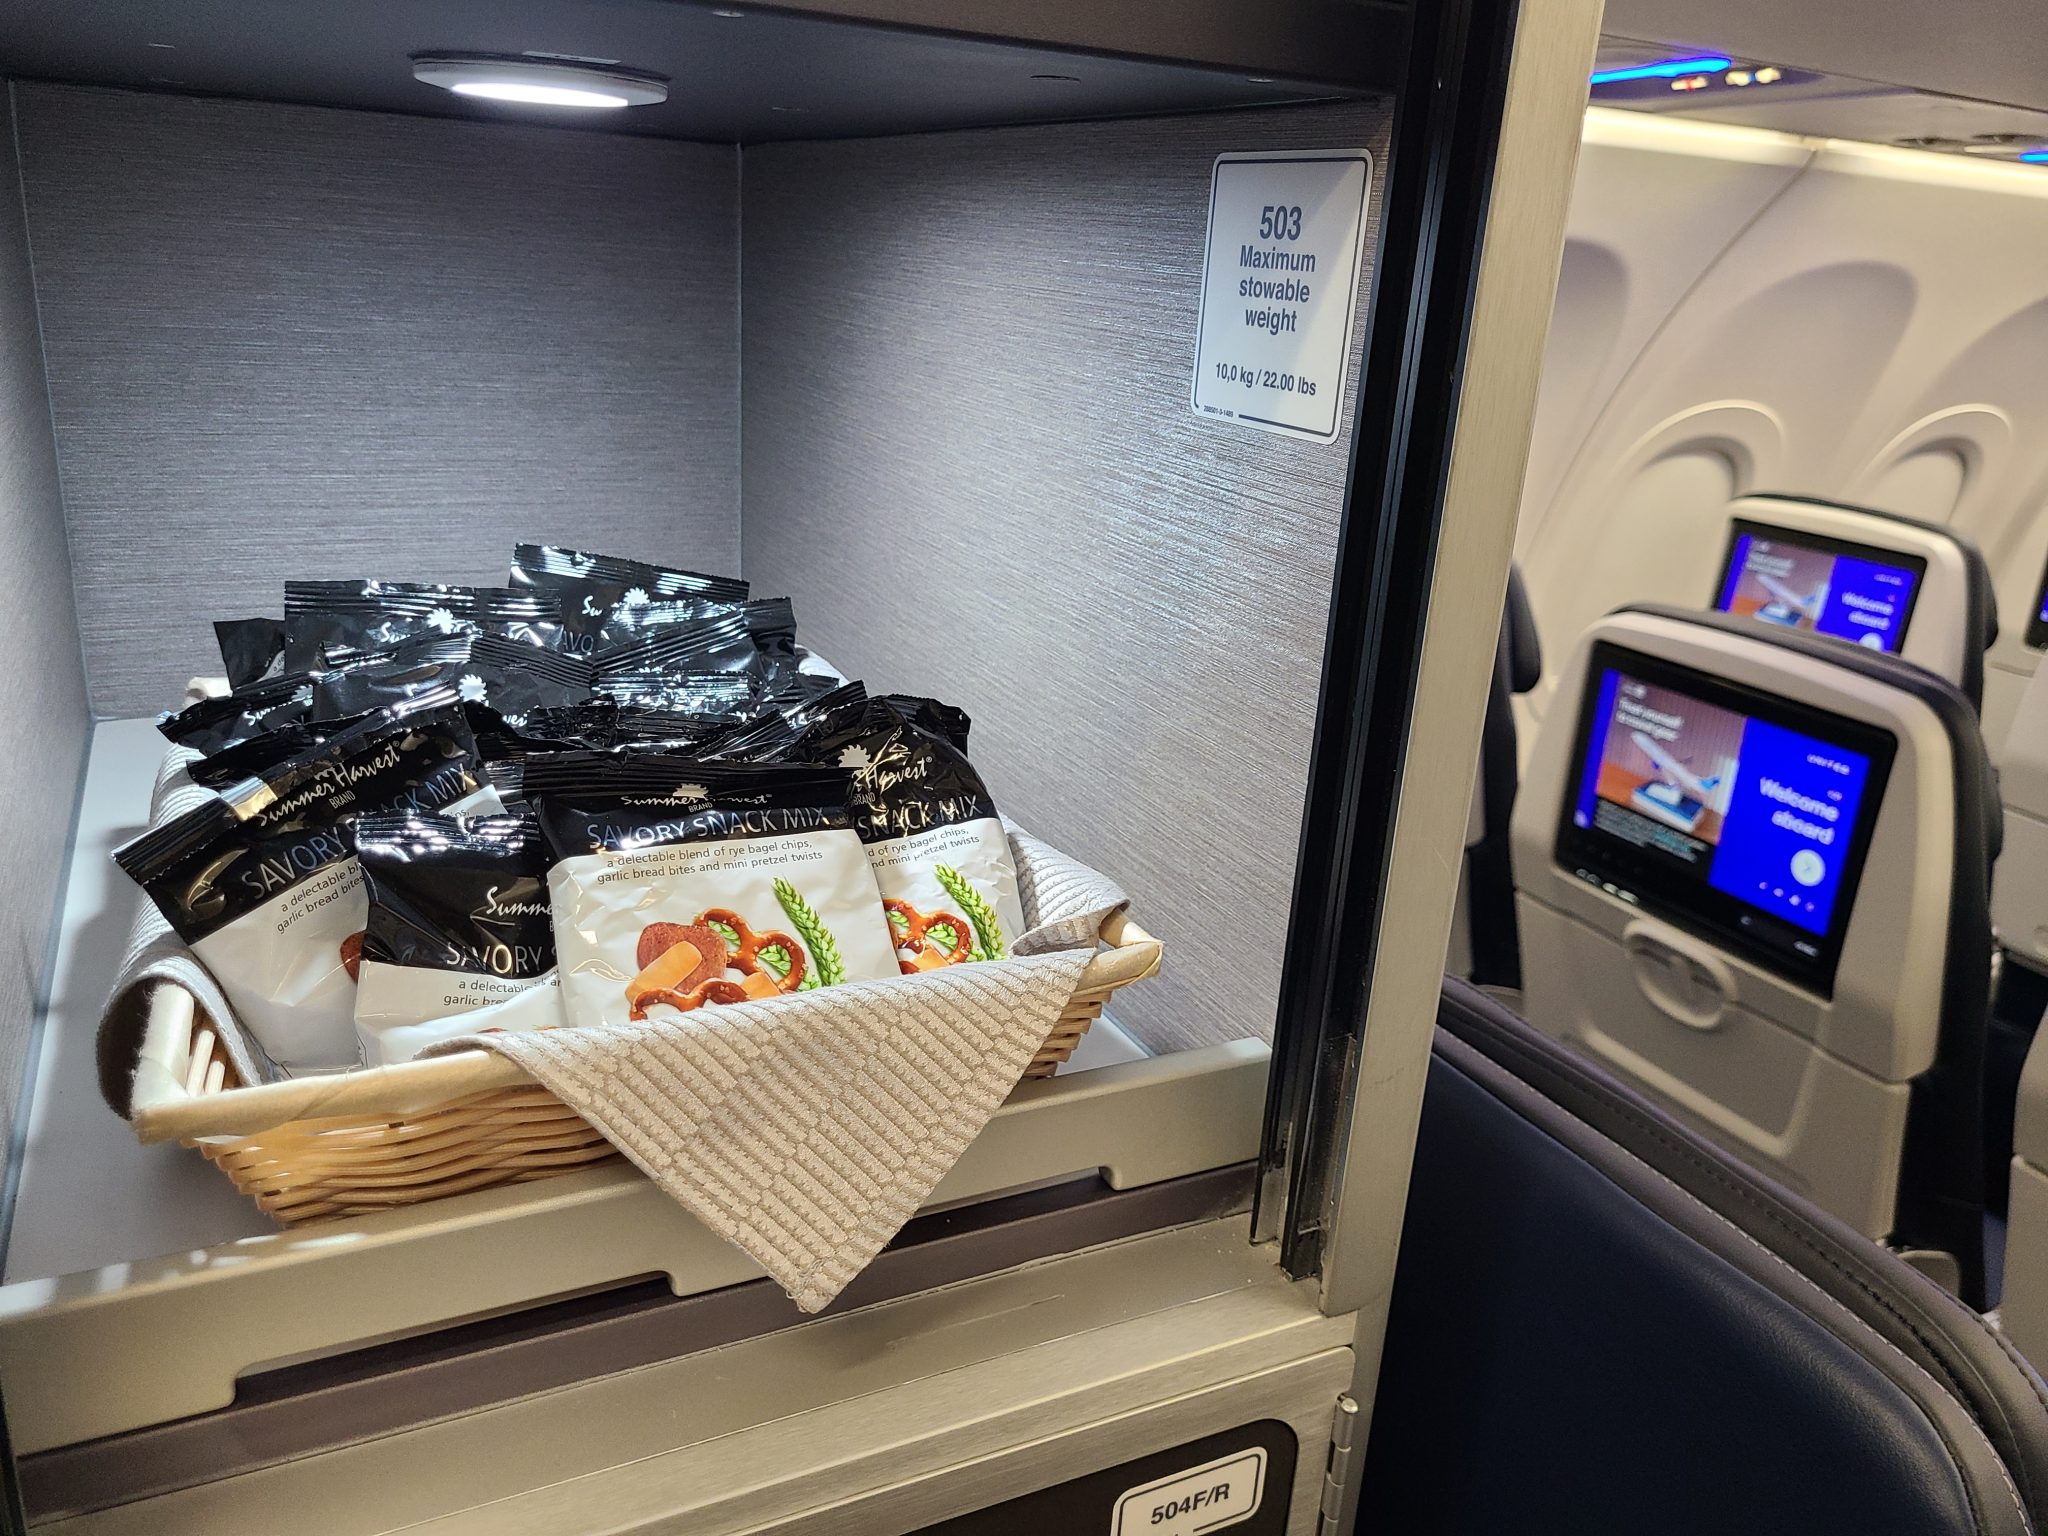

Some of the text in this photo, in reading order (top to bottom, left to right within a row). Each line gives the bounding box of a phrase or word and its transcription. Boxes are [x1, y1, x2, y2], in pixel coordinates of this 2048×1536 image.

[1259, 206, 1302, 240] 503
[1239, 245, 1316, 273] Maximum
[1239, 277, 1310, 303] stowable
[1244, 306, 1298, 336] weight
[1215, 362, 1238, 381] 10,0
[1240, 364, 1254, 388] kg
[1263, 370, 1294, 392] 22.00
[1298, 375, 1317, 396] lbs
[329, 791, 356, 809] BRAND
[688, 801, 713, 813] BRAND
[1759, 776, 1840, 822] Welcome
[241, 826, 348, 900] SAVORY
[424, 763, 477, 804] MIX
[587, 806, 830, 849] SAVORY SNACK MIX
[857, 794, 984, 839] SNACK MIX
[1771, 810, 1836, 846] aboard
[607, 838, 813, 868] a delectable blend of rye bagel chips,
[871, 858, 885, 869] nd
[888, 853, 911, 866] mini
[914, 842, 948, 861] pretzel
[949, 834, 980, 849] twists
[877, 845, 889, 857] of
[891, 844, 907, 855] rye
[909, 834, 937, 850] bagel
[939, 827, 969, 840] chips,
[597, 850, 823, 885] garlic bread bites and mini pretzel twists
[277, 875, 366, 935] garlic bread bites
[281, 872, 346, 912] a delectable
[486, 886, 553, 916] Summe
[443, 994, 479, 1006] garlic
[459, 980, 466, 989] a
[1150, 1483, 1231, 1525] 504F/R
